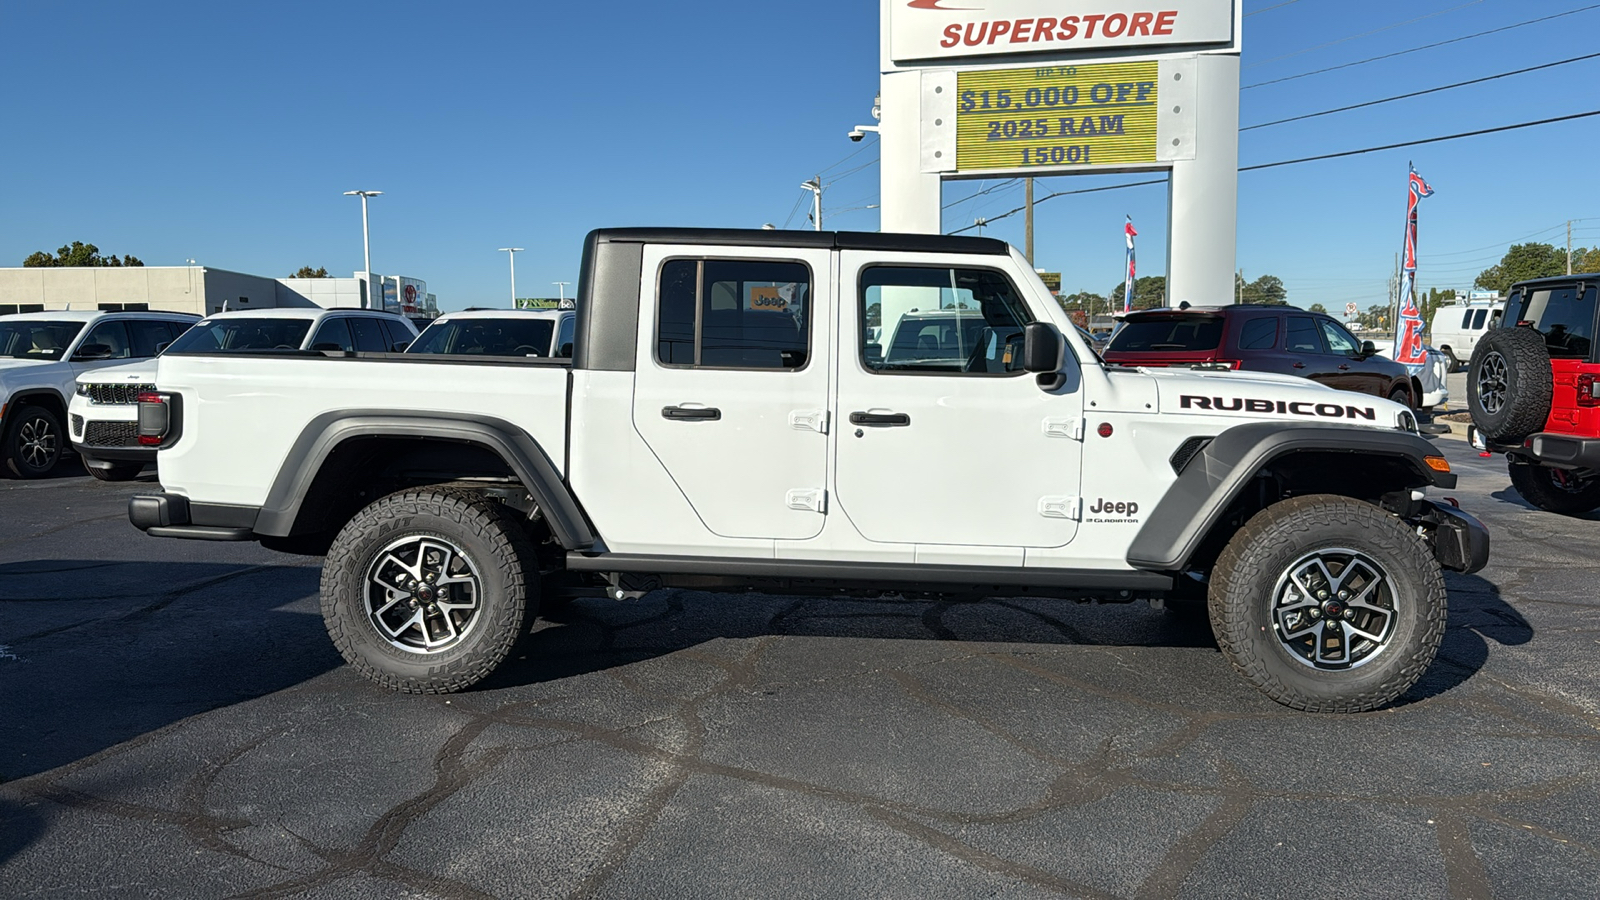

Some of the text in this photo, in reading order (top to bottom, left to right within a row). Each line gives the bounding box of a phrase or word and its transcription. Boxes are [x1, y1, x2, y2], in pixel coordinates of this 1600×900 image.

[940, 11, 1178, 48] SUPERSTORE
[1035, 67, 1077, 78] UP TO
[960, 81, 1155, 113] $15,000 OFF
[987, 114, 1126, 140] 2025 RAM
[1021, 145, 1091, 165] 1500!
[754, 295, 785, 308] Jeep
[1180, 394, 1376, 420] RUBICON
[1089, 498, 1139, 517] Jeep
